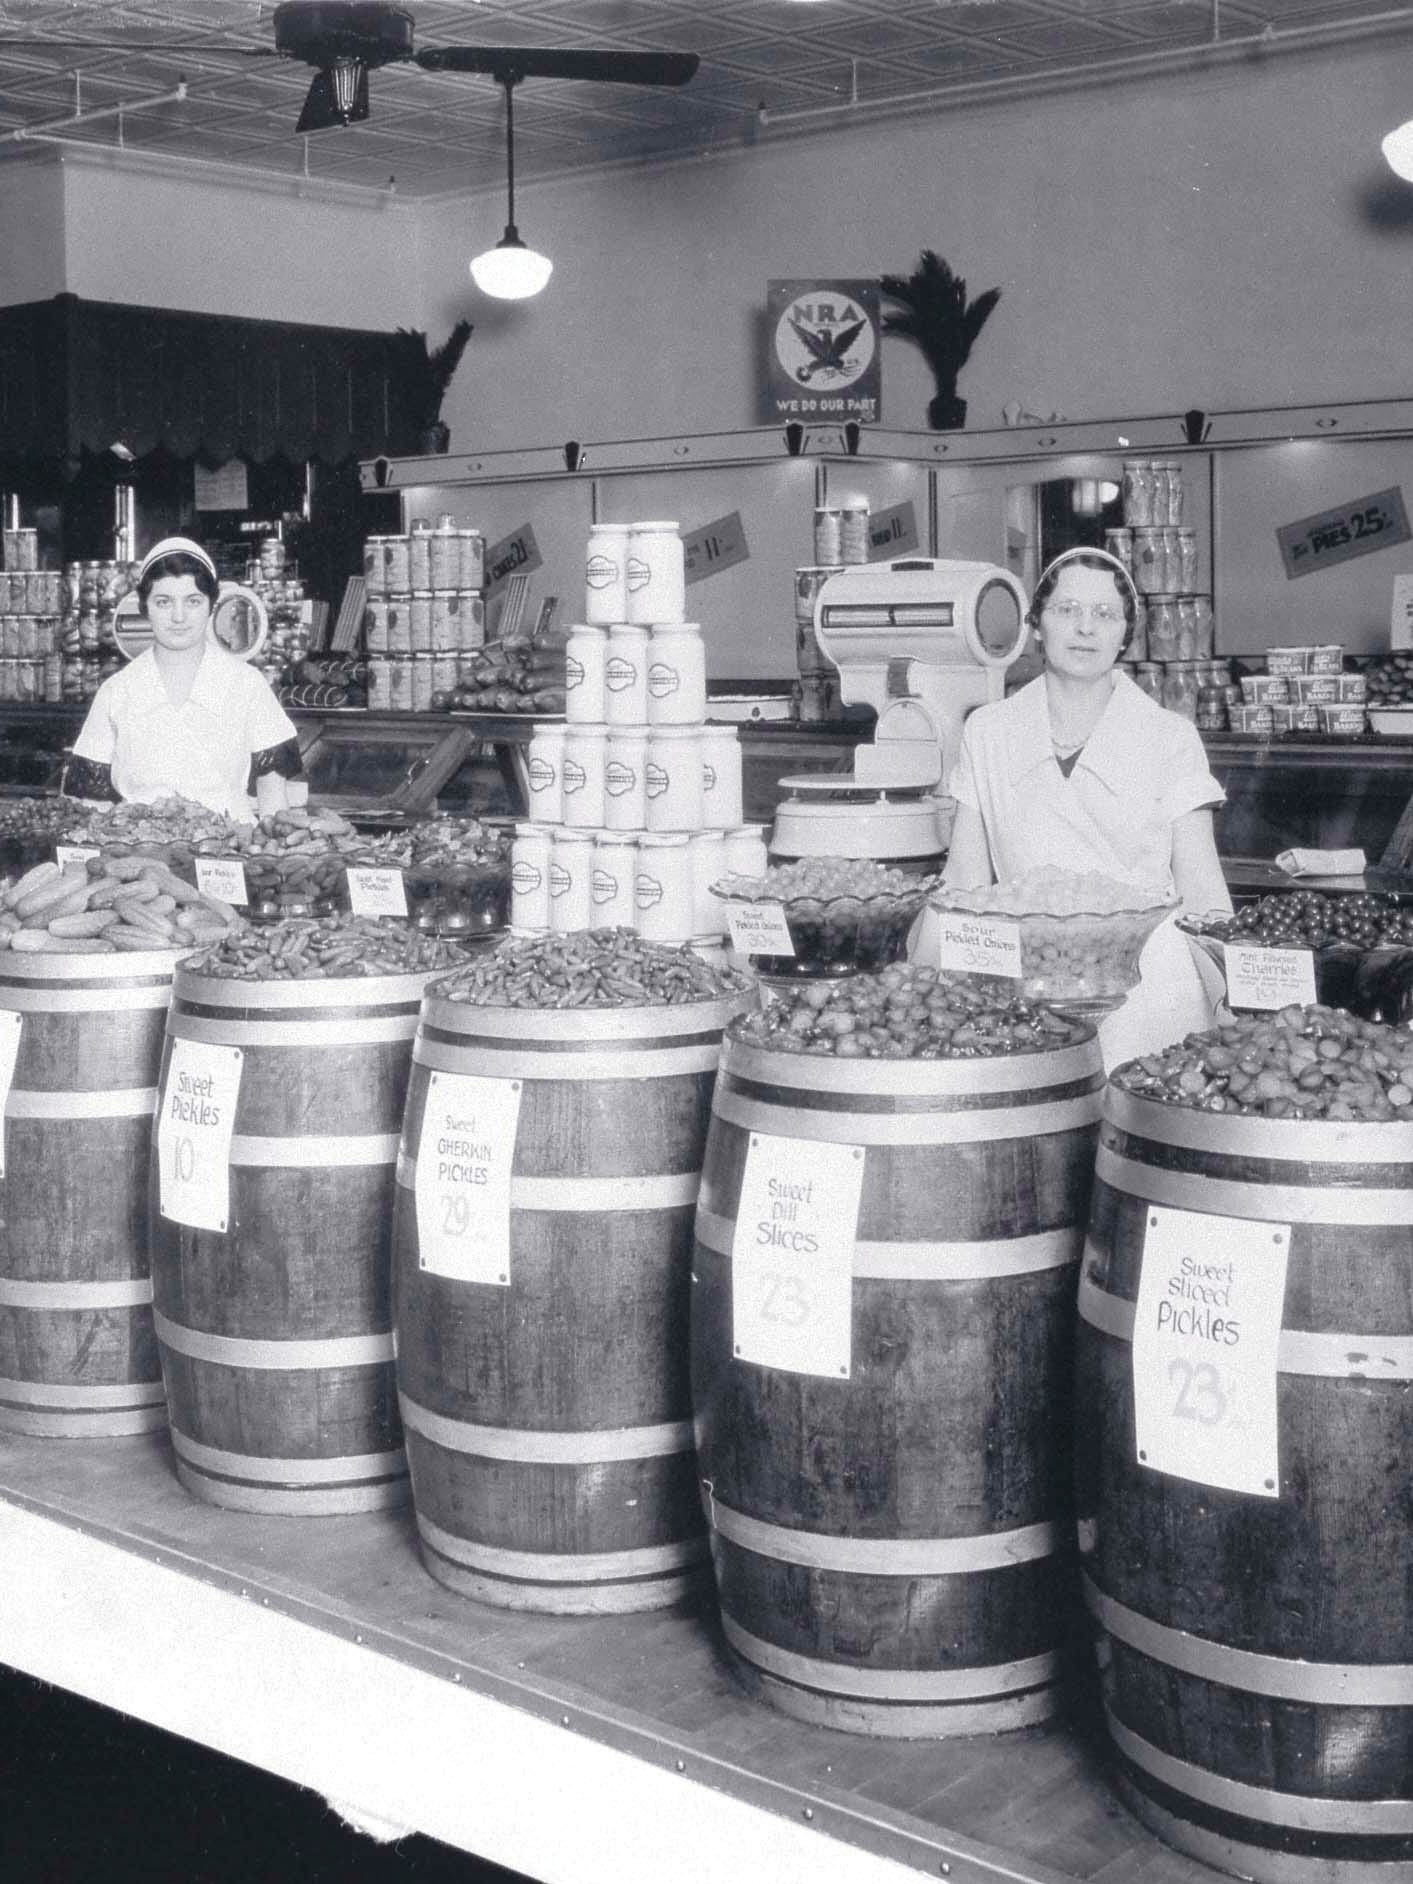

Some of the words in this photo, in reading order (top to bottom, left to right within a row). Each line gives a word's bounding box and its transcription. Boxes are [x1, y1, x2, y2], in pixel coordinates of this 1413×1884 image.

[794, 304, 859, 322] NRA
[777, 400, 798, 411] WE
[802, 400, 816, 411] DO
[820, 400, 844, 411] OUR
[848, 399, 876, 411] PART
[962, 923, 996, 937] Sour
[178, 1072, 214, 1098] Sweet
[171, 1096, 220, 1126] Pickles
[437, 1138, 493, 1162] GHERKIN
[438, 1162, 488, 1185] PICKLES
[768, 1178, 813, 1204] Sweet
[772, 1201, 797, 1222] Dill
[756, 1221, 819, 1252] Slices
[1180, 1257, 1234, 1284] Sweet
[1157, 1301, 1241, 1346] Pickles
[1167, 1357, 1227, 1425] 23
